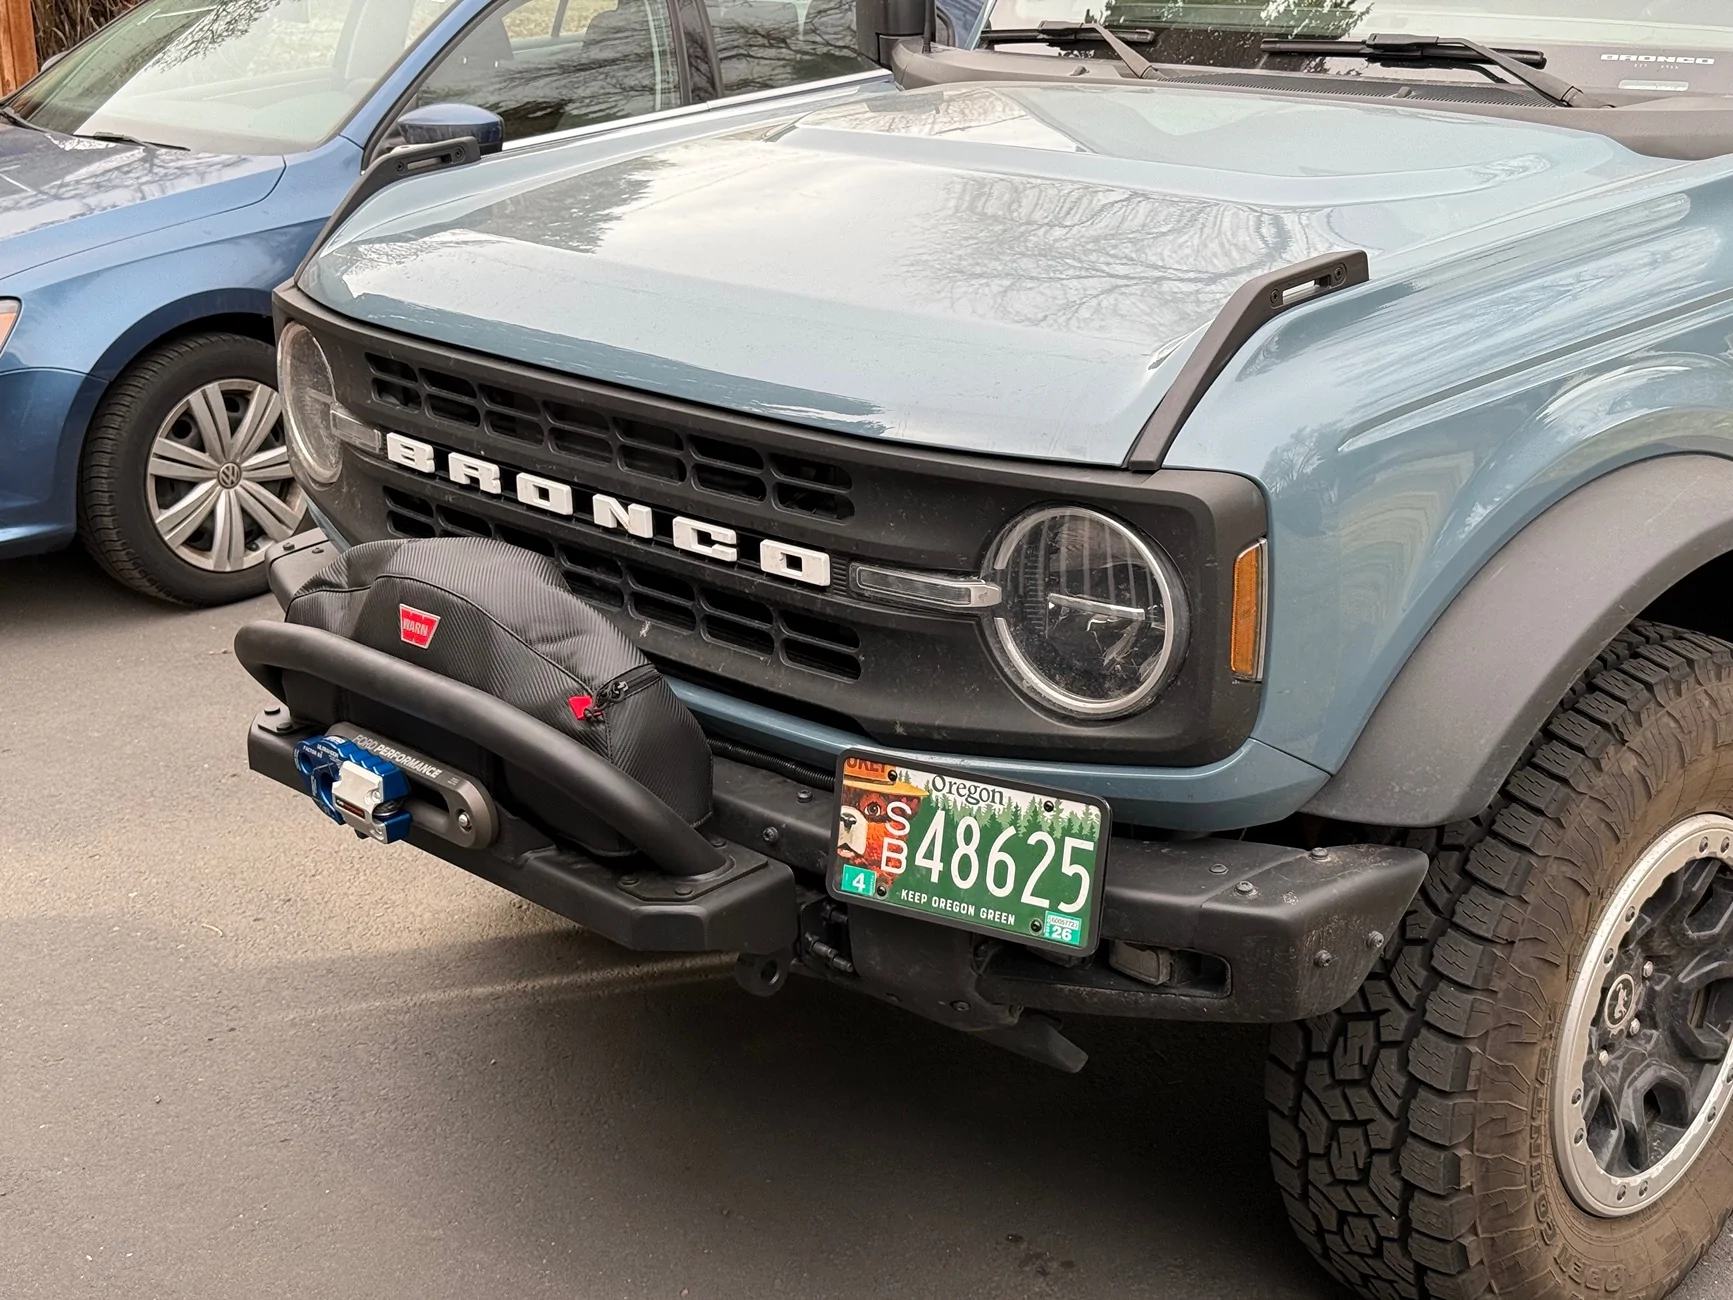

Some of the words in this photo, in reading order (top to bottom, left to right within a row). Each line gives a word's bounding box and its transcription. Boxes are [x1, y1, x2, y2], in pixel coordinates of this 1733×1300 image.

[386, 432, 831, 587] BRONCO
[403, 618, 429, 637] WARN
[352, 734, 378, 750] FORD
[374, 744, 442, 778] PERFORMANCE
[931, 774, 1004, 806] Oregon
[914, 809, 1095, 914] 48625
[852, 872, 866, 893] 4
[901, 888, 928, 905] KEEP
[931, 896, 976, 917] OREGON
[980, 907, 1016, 926] GREEN
[1051, 925, 1072, 941] 26
